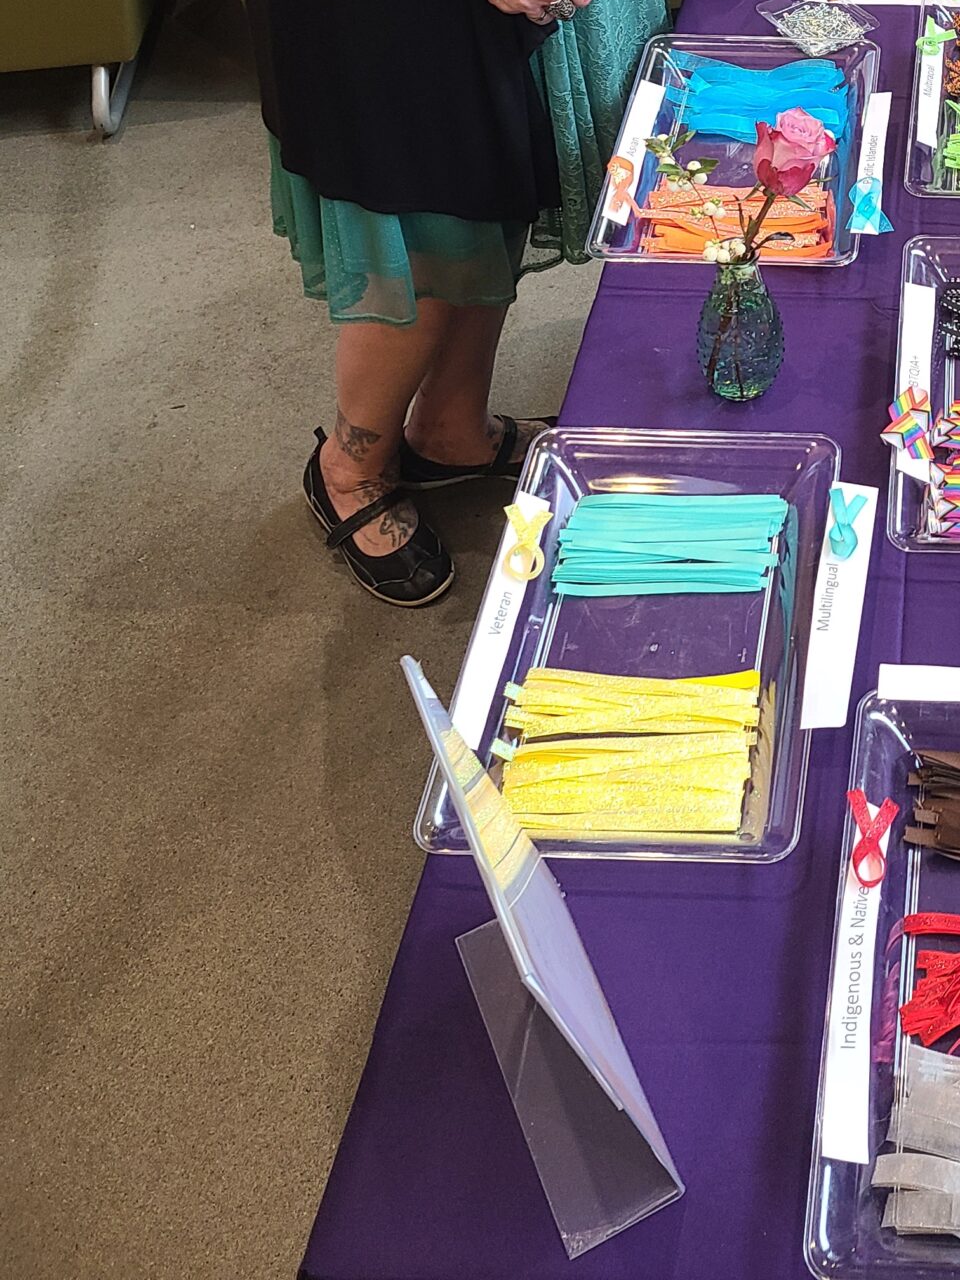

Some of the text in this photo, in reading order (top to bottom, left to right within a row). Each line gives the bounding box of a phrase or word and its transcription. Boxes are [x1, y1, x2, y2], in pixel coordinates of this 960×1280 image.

[626, 137, 640, 157] Asian
[866, 135, 878, 162] Islander
[908, 355, 921, 387] BTQIA+
[487, 591, 512, 635] Veteran
[816, 563, 839, 631] Multilingual
[840, 886, 870, 1050] Indigenous & Native
